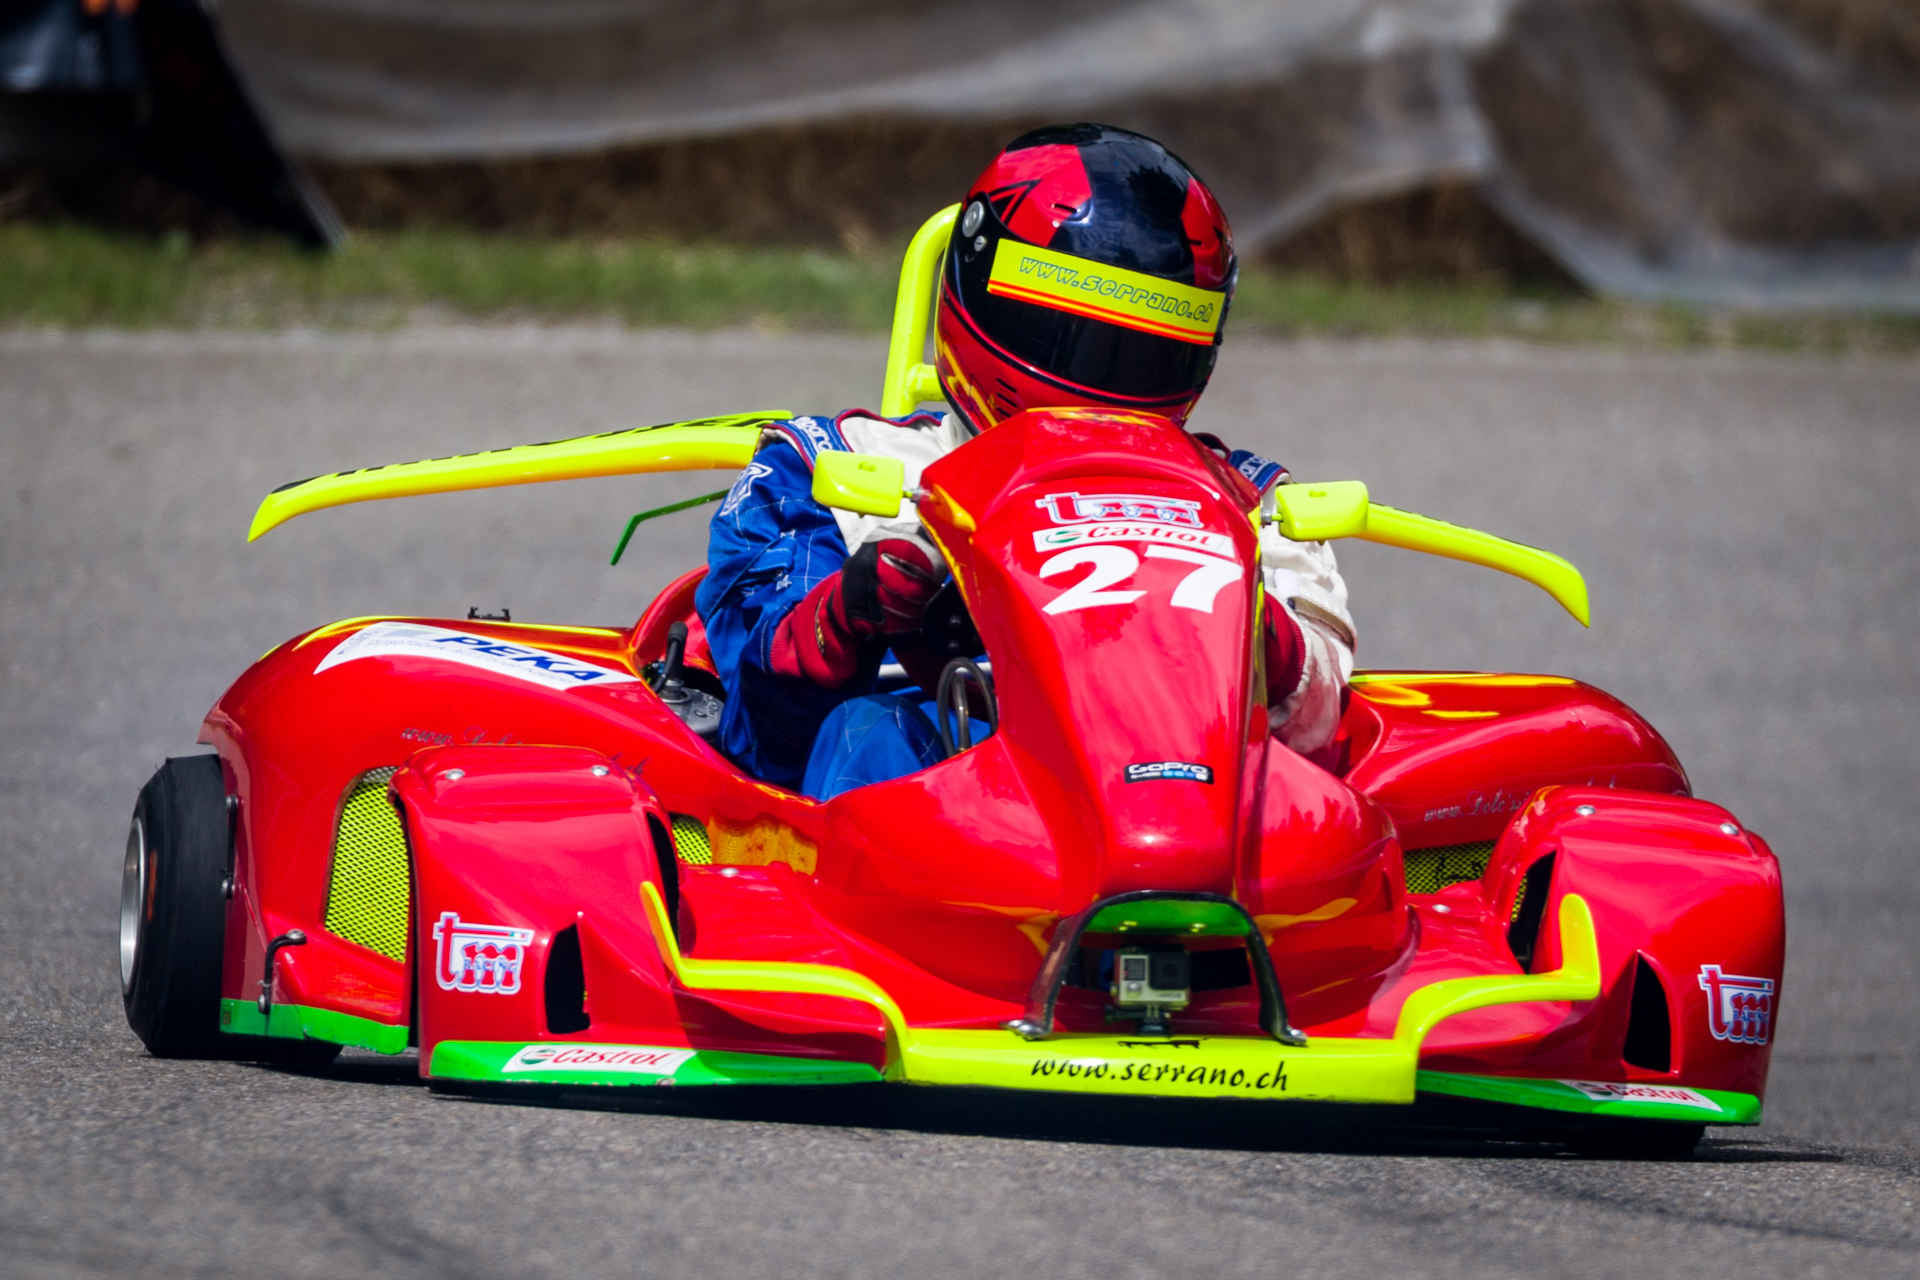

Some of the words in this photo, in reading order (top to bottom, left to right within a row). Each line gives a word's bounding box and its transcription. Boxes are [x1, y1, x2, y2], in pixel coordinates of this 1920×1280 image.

[1018, 256, 1214, 323] www.serrano.ch
[1087, 526, 1210, 546] Castrol
[1039, 545, 1244, 615] 27
[432, 636, 607, 681] PEKA
[1128, 761, 1208, 775] GoPro
[463, 958, 517, 974] RACING
[1733, 1010, 1769, 1023] RACING
[553, 1049, 671, 1066] Castrol
[1030, 1059, 1287, 1091] www.serrano.ch
